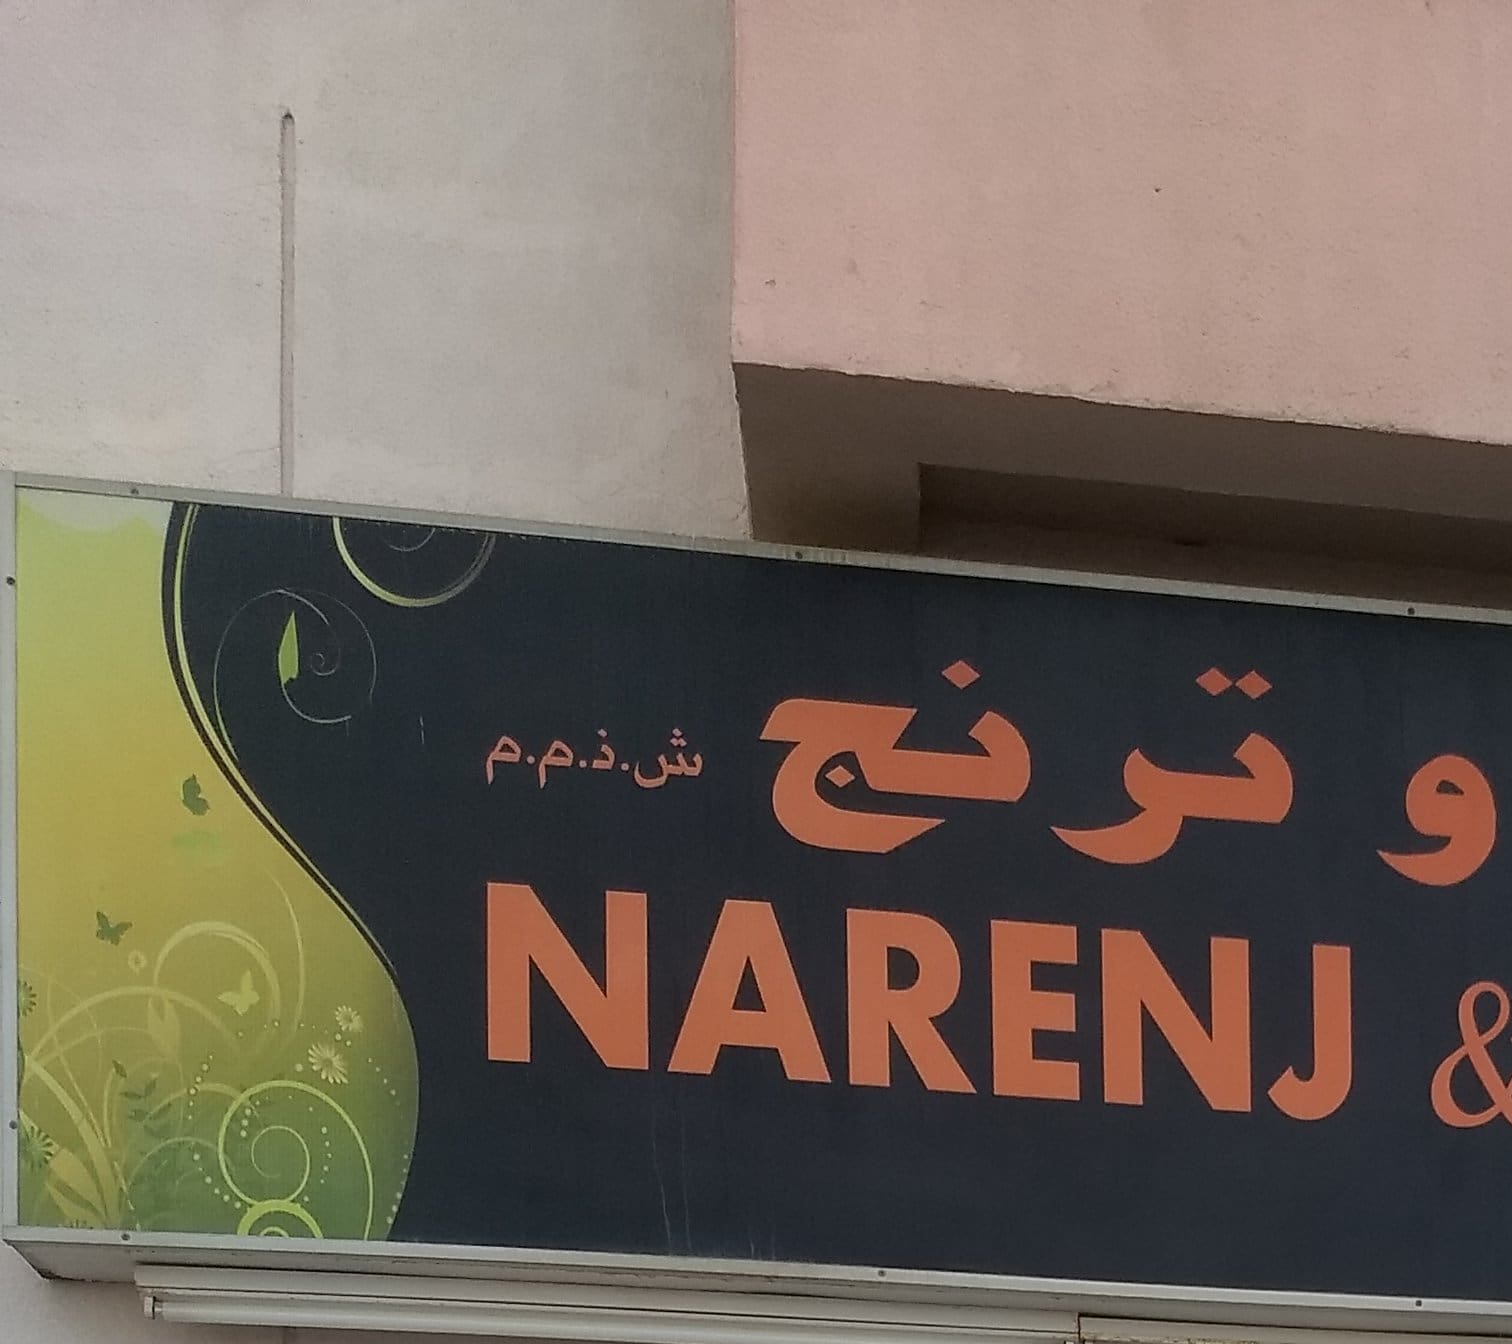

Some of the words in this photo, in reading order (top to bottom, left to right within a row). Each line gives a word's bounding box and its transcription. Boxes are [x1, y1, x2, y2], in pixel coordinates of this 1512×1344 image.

[759, 659, 1294, 865] ترنج
[1377, 753, 1498, 887] و
[486, 881, 1353, 1121] NARENJ
